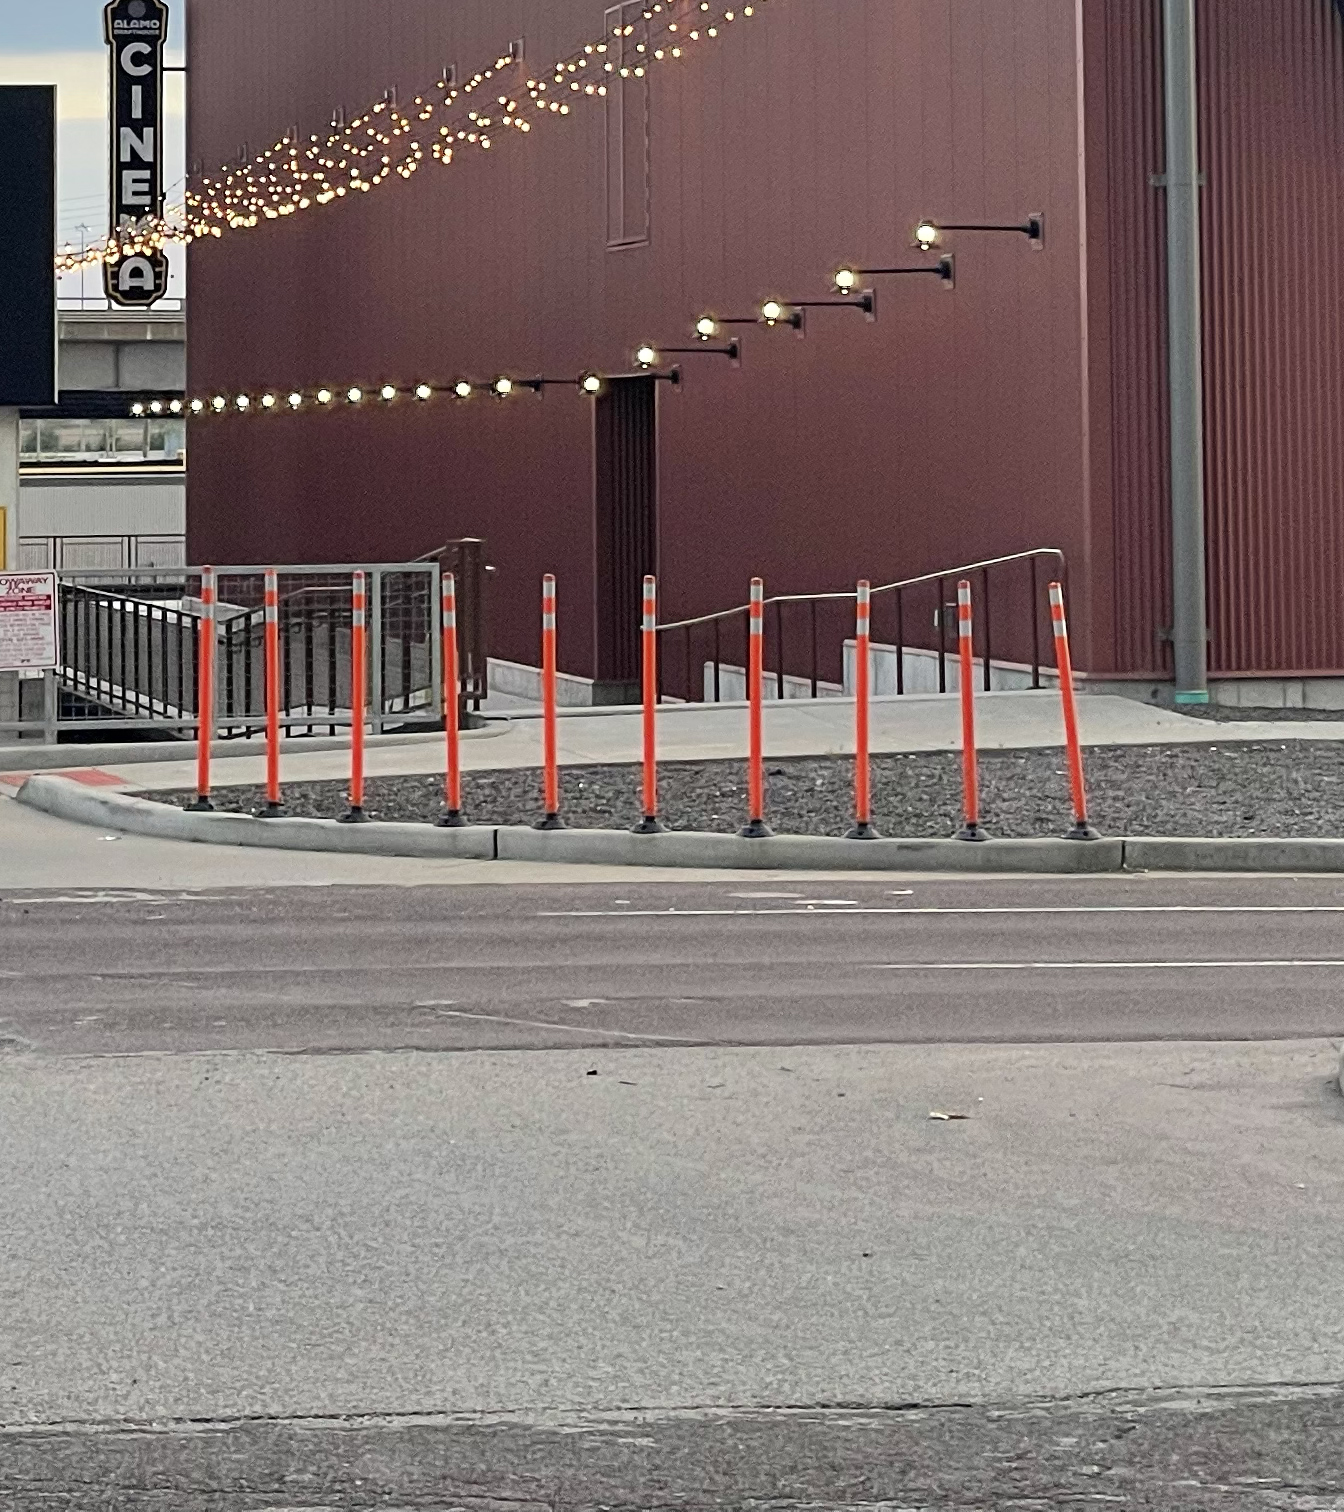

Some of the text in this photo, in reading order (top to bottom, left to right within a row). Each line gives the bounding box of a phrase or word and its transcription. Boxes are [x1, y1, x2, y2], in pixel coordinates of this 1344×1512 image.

[113, 19, 160, 29] ALAMO
[119, 42, 155, 292] CINEMA
[6, 586, 35, 595] ZONE
